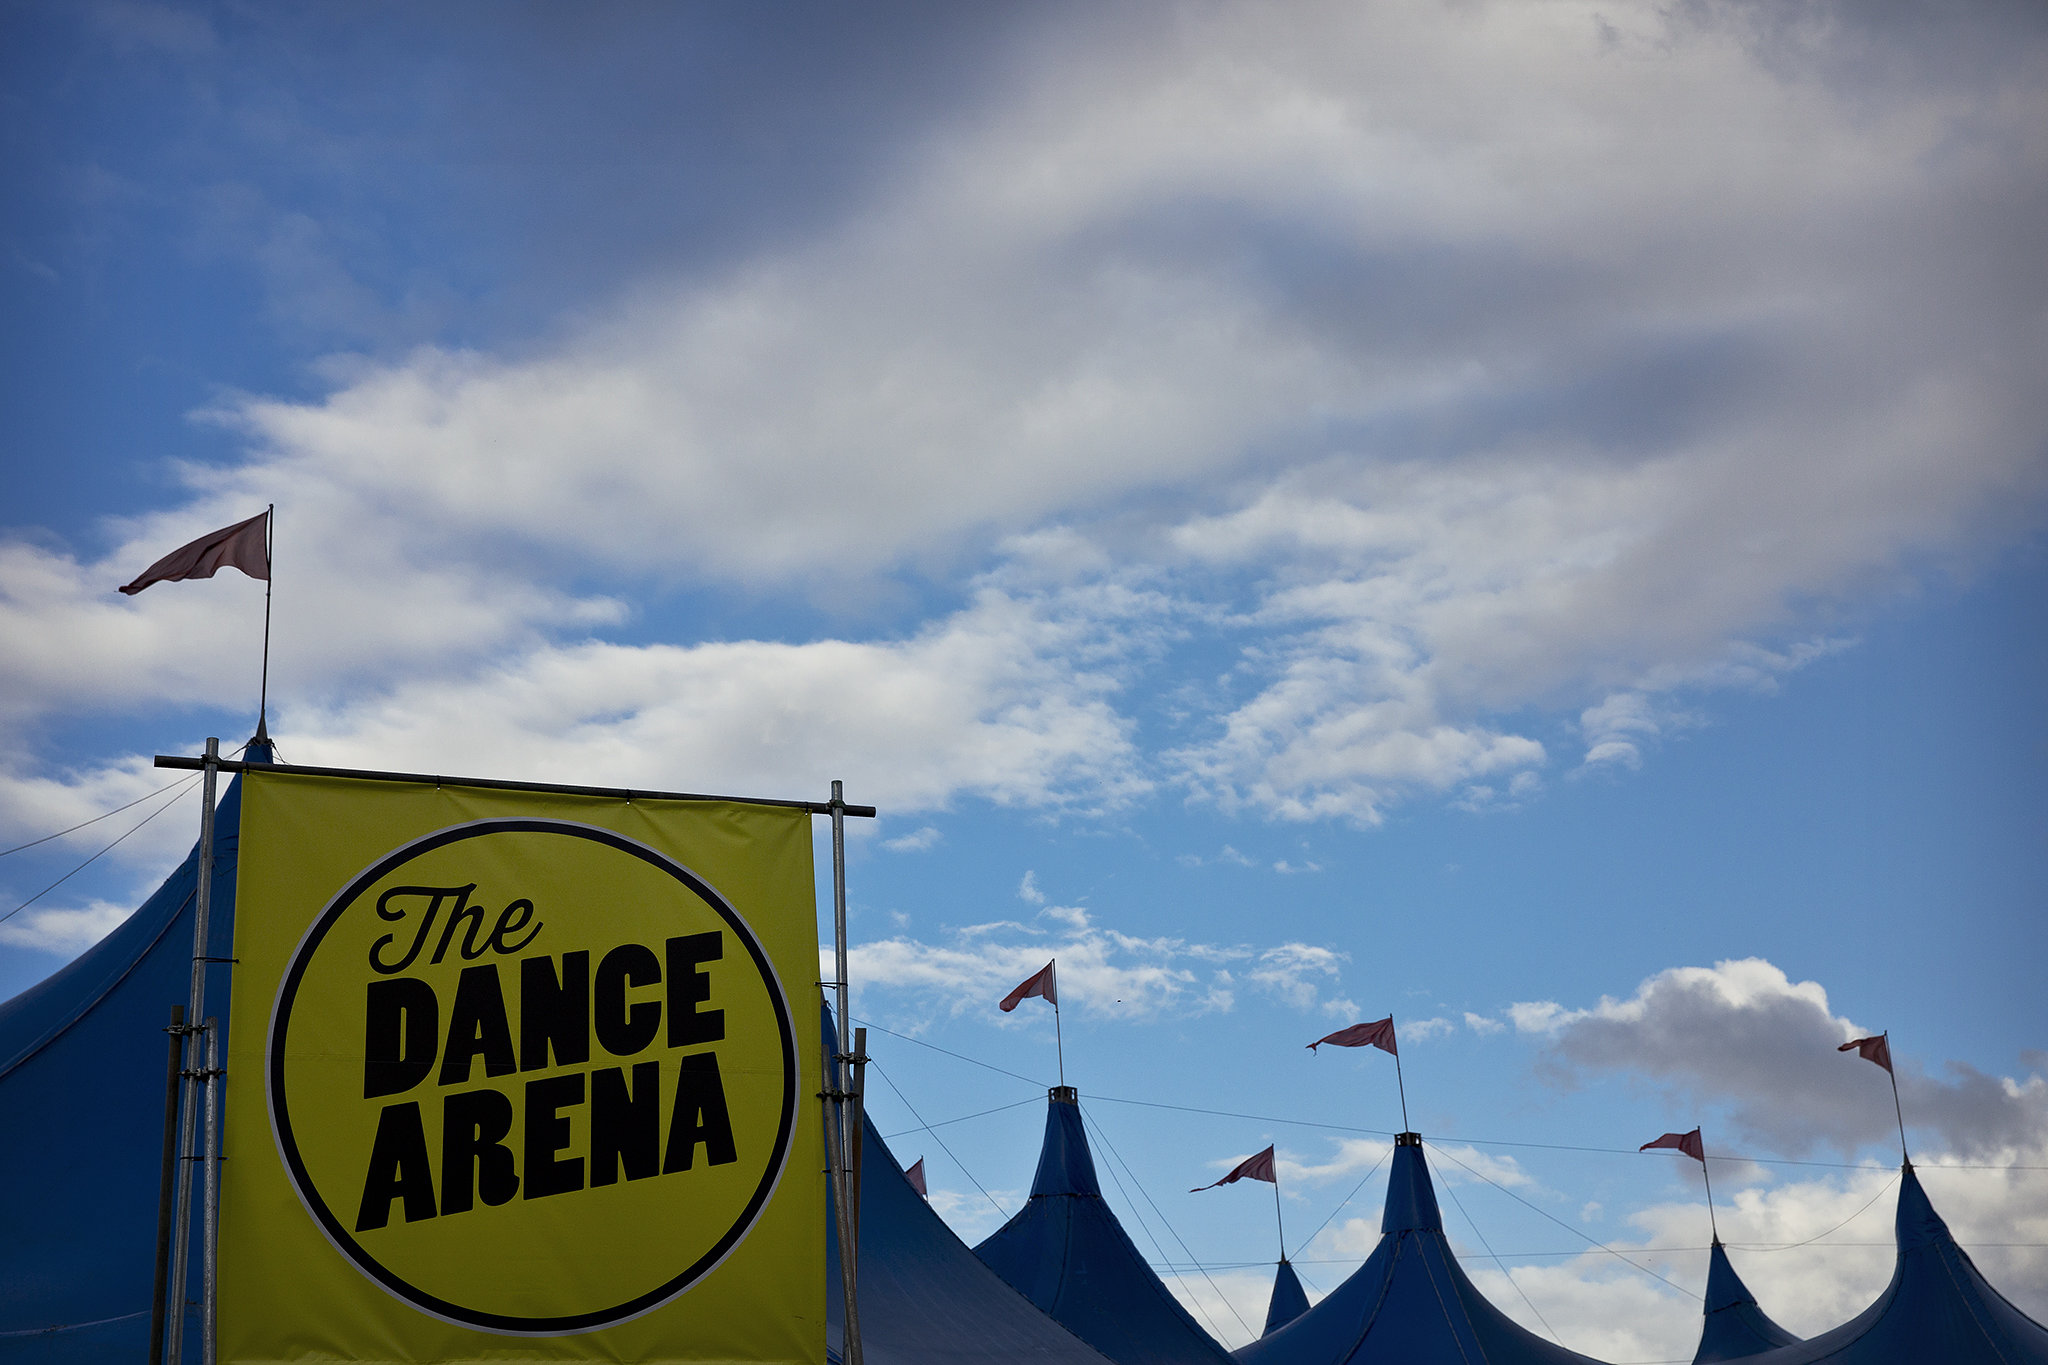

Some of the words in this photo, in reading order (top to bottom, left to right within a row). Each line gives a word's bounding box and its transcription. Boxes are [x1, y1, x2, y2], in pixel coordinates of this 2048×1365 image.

[368, 882, 544, 975] The
[363, 930, 726, 1100] DANCE
[354, 1051, 738, 1233] ARENA
